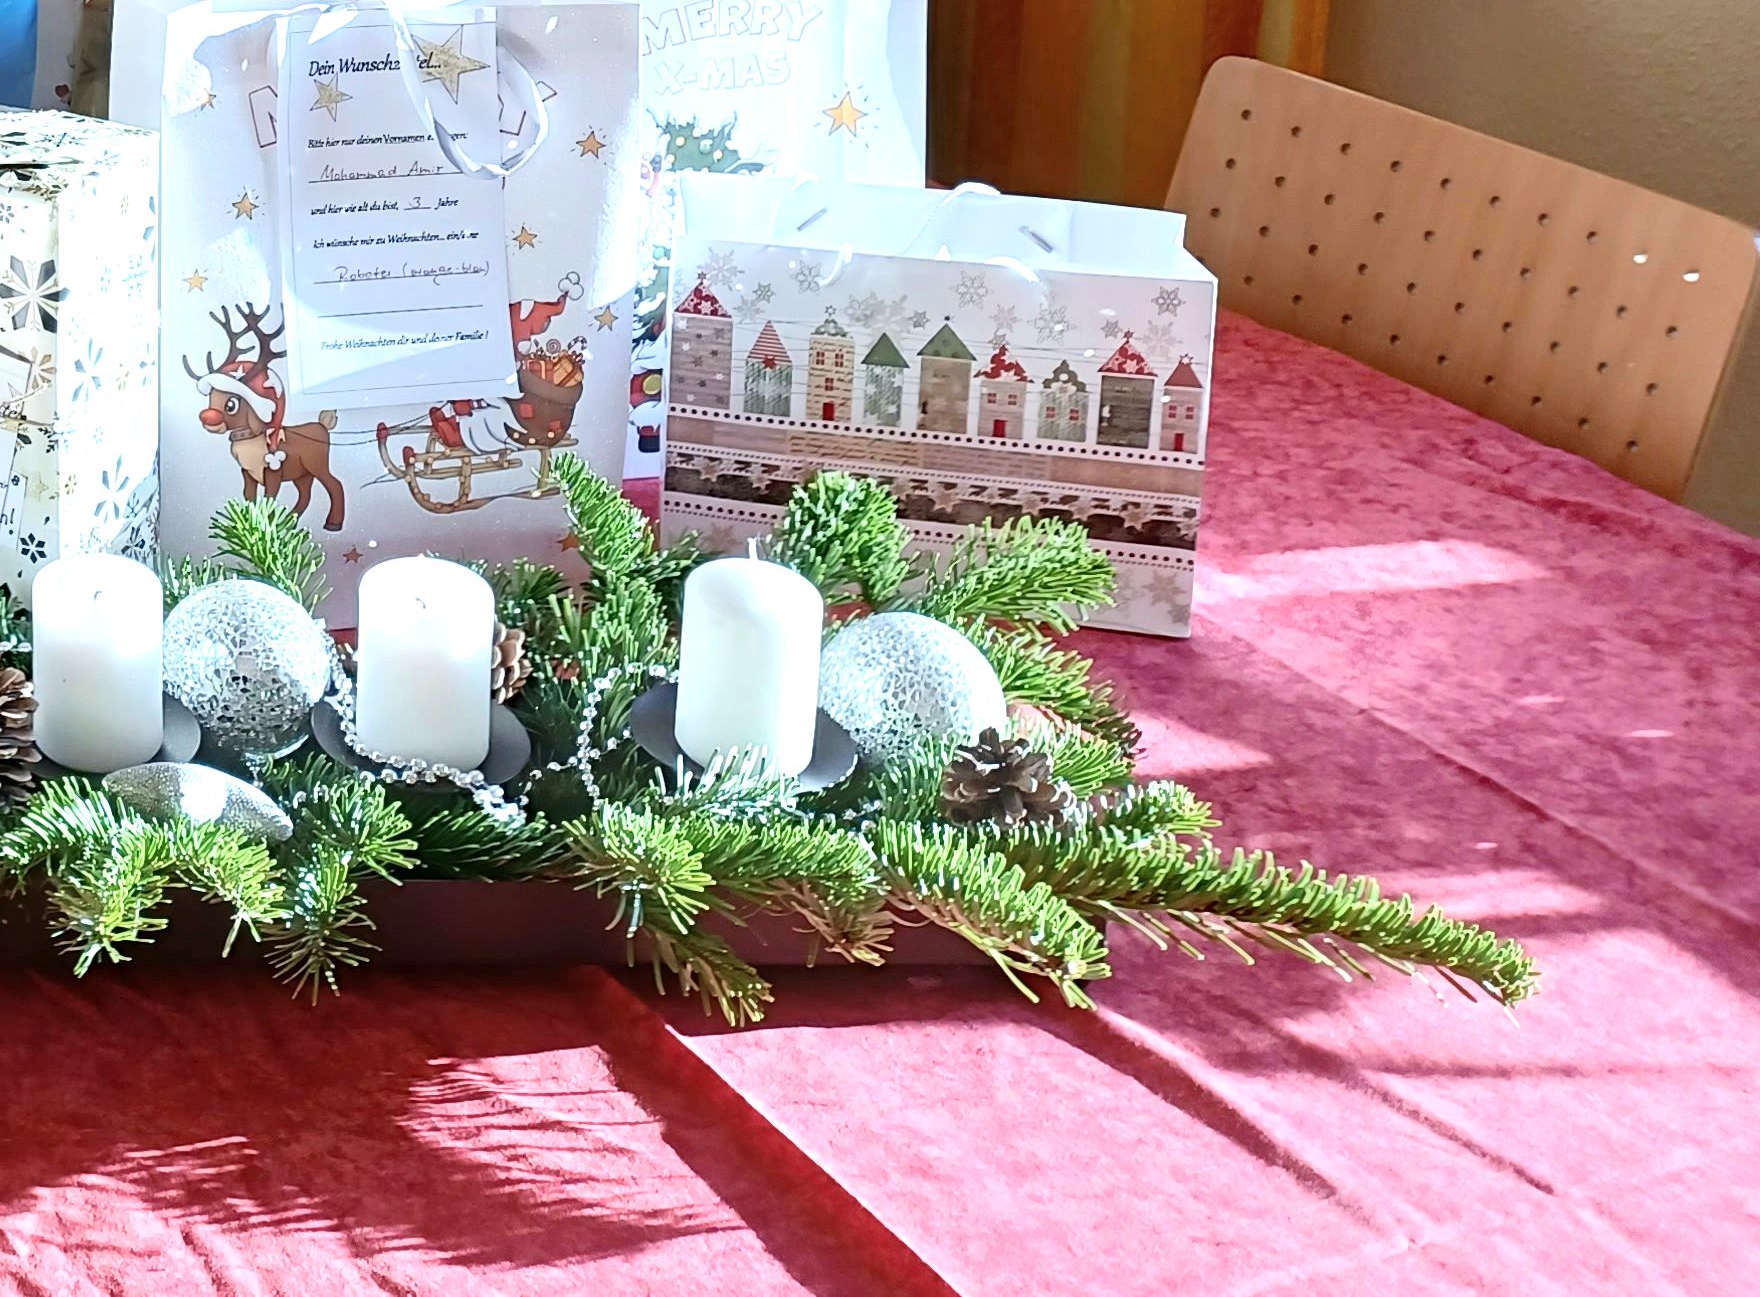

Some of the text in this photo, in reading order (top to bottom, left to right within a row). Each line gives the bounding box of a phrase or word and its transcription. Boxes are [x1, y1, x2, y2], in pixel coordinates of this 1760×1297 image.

[308, 59, 335, 77] Dein
[653, 50, 792, 97] X-MAS
[325, 135, 340, 148] hier
[356, 134, 383, 146] deinen
[383, 133, 426, 144] Vornamen
[310, 204, 327, 215] und
[327, 202, 343, 214] hier
[344, 204, 357, 214] wie
[357, 201, 369, 212] alt
[369, 200, 381, 212] du
[408, 196, 422, 208] 3
[434, 197, 459, 210] Jahre
[313, 238, 325, 249] Ich
[326, 237, 359, 248] wünsche
[360, 237, 375, 247] mir
[333, 265, 391, 283] Roboter
[321, 340, 343, 351] Frohe
[345, 335, 396, 350] Weihnachten
[397, 333, 409, 346] dir
[410, 332, 428, 345] und
